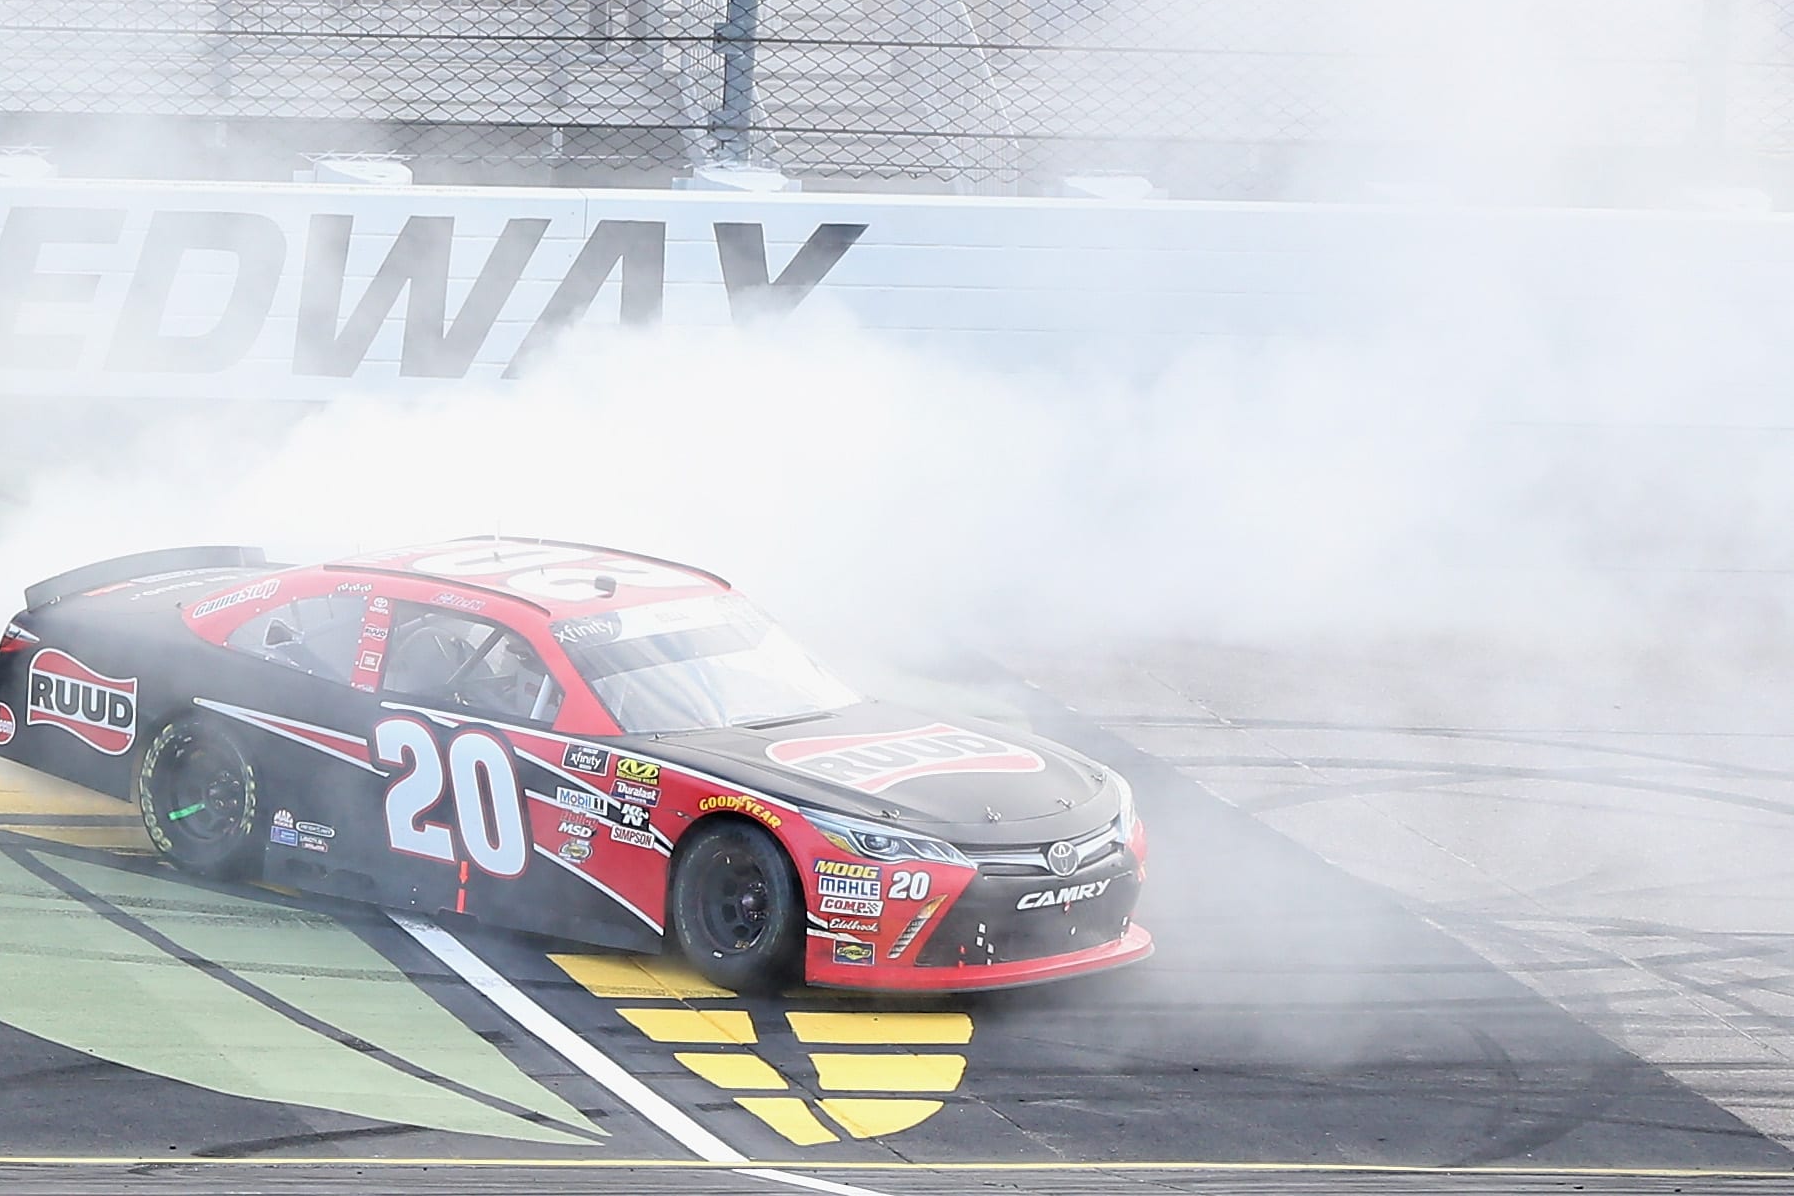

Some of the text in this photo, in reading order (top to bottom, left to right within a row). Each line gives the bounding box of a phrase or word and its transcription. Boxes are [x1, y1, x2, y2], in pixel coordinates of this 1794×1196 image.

[194, 578, 281, 618] GameStop
[554, 618, 614, 644] xfinity
[30, 672, 134, 729] RUUD
[570, 751, 602, 770] xfinity
[793, 732, 1010, 783] RUUD
[376, 717, 527, 878] 20
[559, 789, 592, 806] Mobil
[616, 781, 657, 801] Duralast
[558, 822, 593, 838] MSD
[613, 827, 653, 846] SIMPSON
[814, 860, 880, 879] MOOG
[821, 877, 879, 896] MAHLE
[888, 871, 930, 900] 20
[1016, 878, 1111, 910] CAMRY
[824, 899, 867, 912] COMP
[829, 918, 879, 933] Edelbrock
